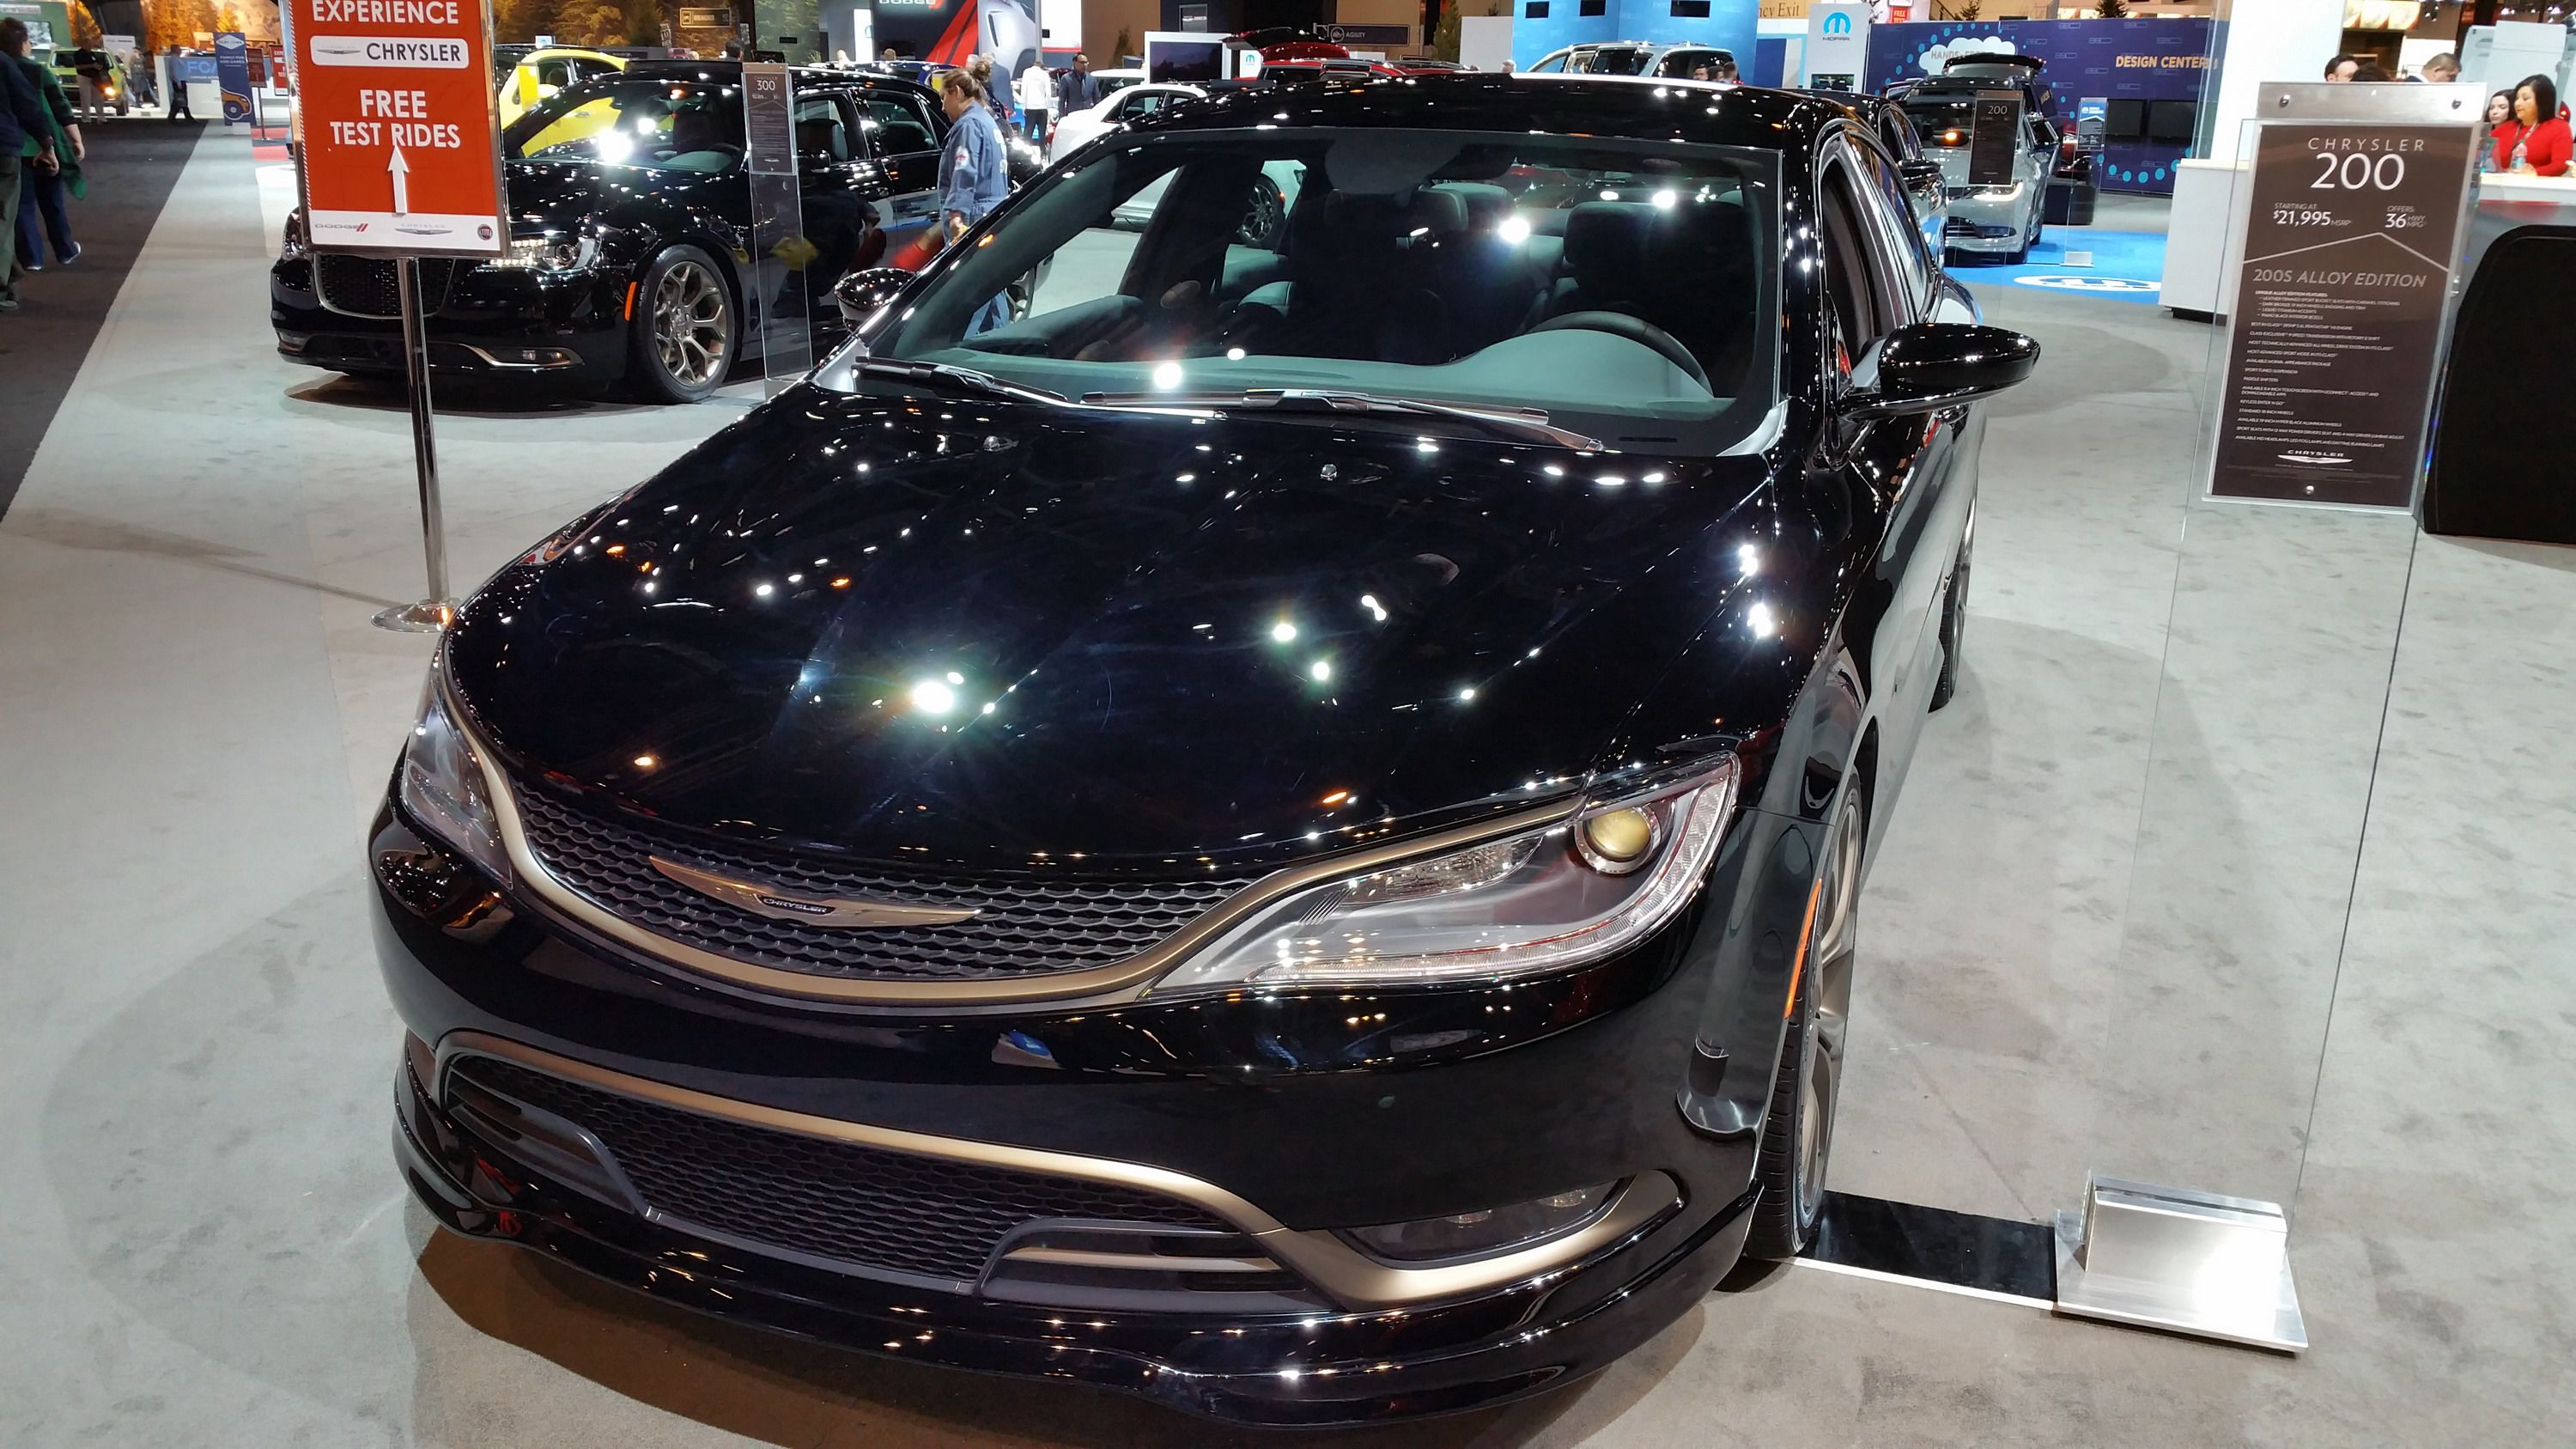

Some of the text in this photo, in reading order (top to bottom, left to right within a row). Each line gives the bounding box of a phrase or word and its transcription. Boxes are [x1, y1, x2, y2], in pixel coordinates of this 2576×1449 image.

[312, 0, 460, 24] EXPERIENCE
[1777, 2, 1800, 17] Exit
[366, 42, 461, 62] CHRYSLER
[2115, 56, 2158, 68] DESIGN
[756, 80, 775, 91] 300
[360, 89, 428, 119] FREE
[1987, 105, 2008, 114] 200
[330, 121, 461, 148] TEST RIDES
[2307, 137, 2425, 151] CHRYSLER
[2310, 152, 2405, 191] 200
[2273, 210, 2332, 227] $21,995
[2385, 213, 2407, 228] 36
[2252, 269, 2427, 288] 200S ALLOY EDITION
[762, 898, 827, 912] CHRYSLER
